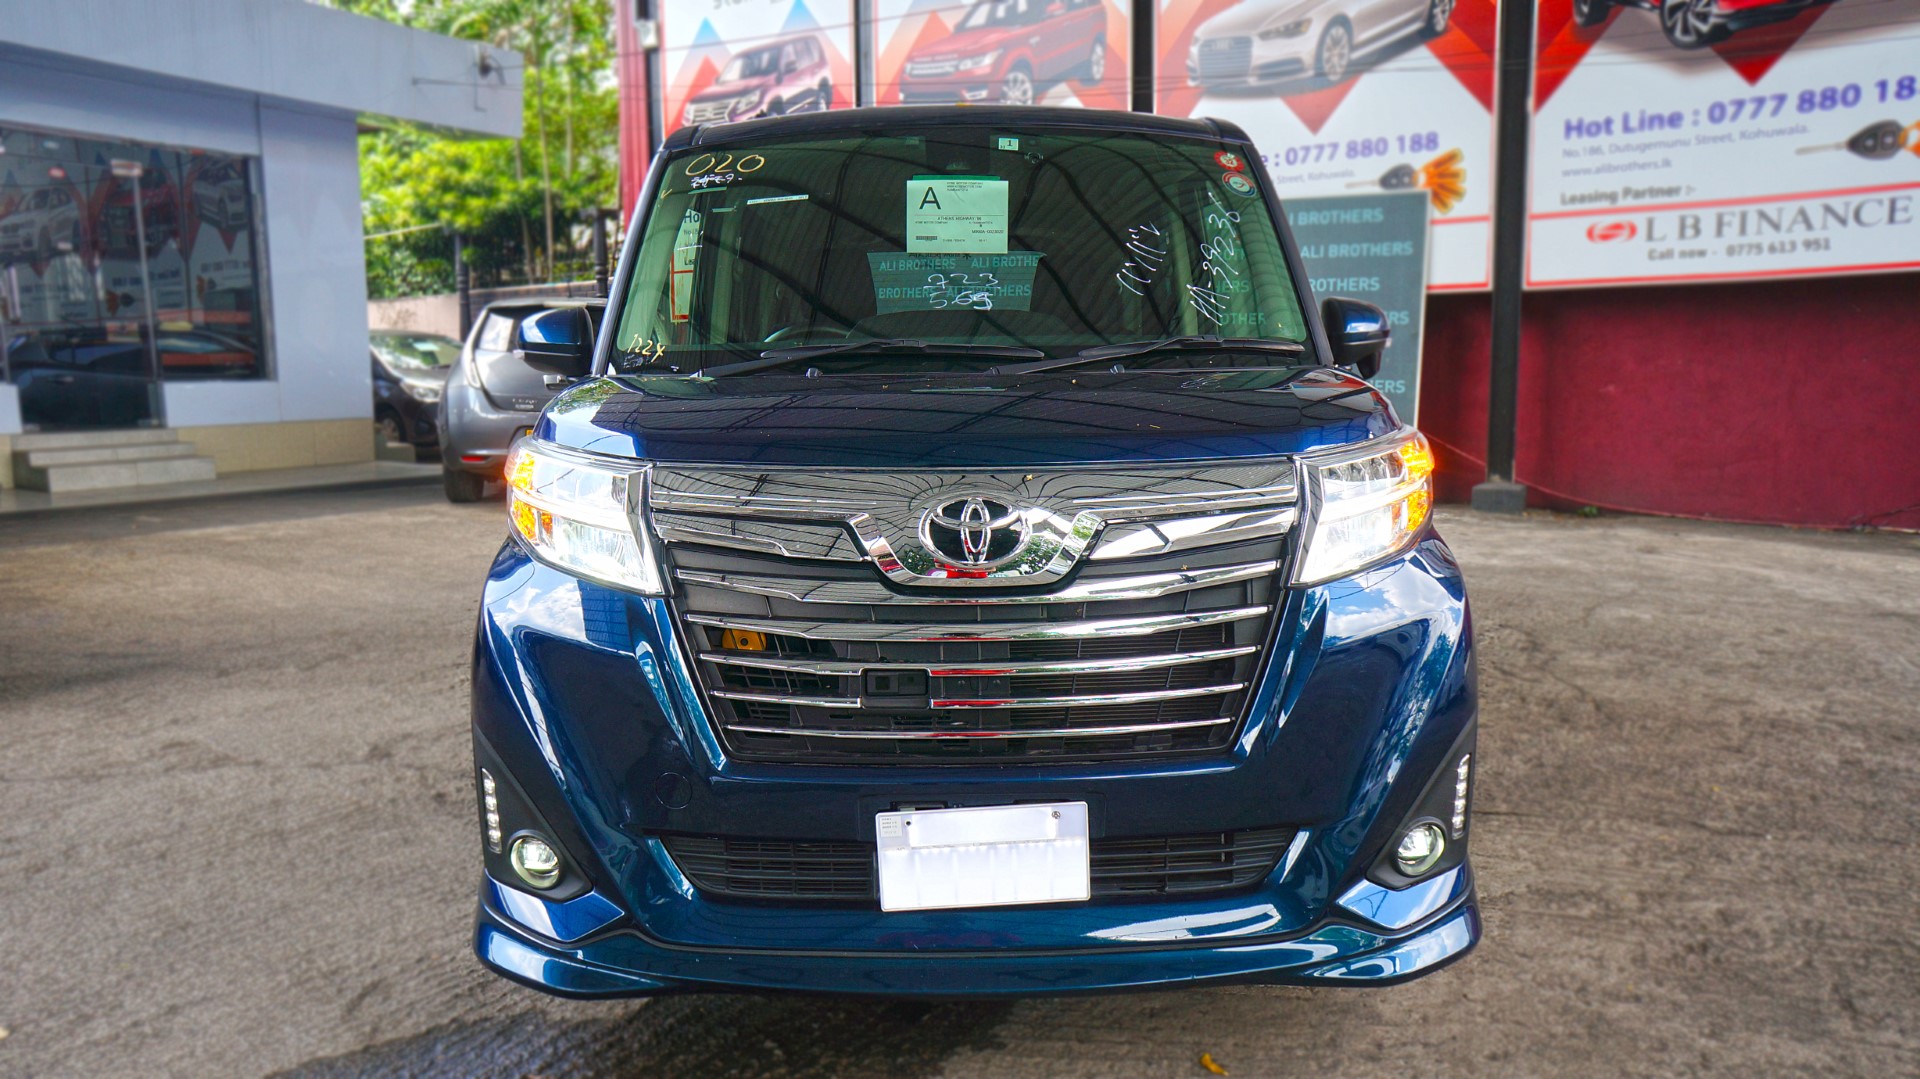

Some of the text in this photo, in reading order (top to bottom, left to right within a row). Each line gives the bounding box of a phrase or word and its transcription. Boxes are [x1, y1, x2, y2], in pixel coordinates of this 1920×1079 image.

[1563, 116, 1614, 140] Hot
[1621, 109, 1684, 134] Line
[1707, 93, 1788, 124] 0777
[1796, 82, 1862, 114] 880
[1875, 75, 1920, 103] 18
[1285, 142, 1340, 166] 0777
[1345, 136, 1389, 159] 880
[1396, 131, 1439, 153] 188
[919, 187, 941, 210] A
[1560, 190, 1619, 206] Leasing
[1622, 184, 1682, 200] Partner
[1297, 207, 1384, 226] BROTHERS
[1714, 195, 1914, 239] FINANCE
[1300, 241, 1414, 259] ALI BROTHERS
[1648, 248, 1675, 261] Call
[1678, 248, 1708, 260] now
[1725, 243, 1764, 258] 0775
[1802, 238, 1831, 252] 951
[879, 261, 896, 271] ALI
[900, 258, 956, 271] BROTHERS
[971, 257, 989, 269] ALI
